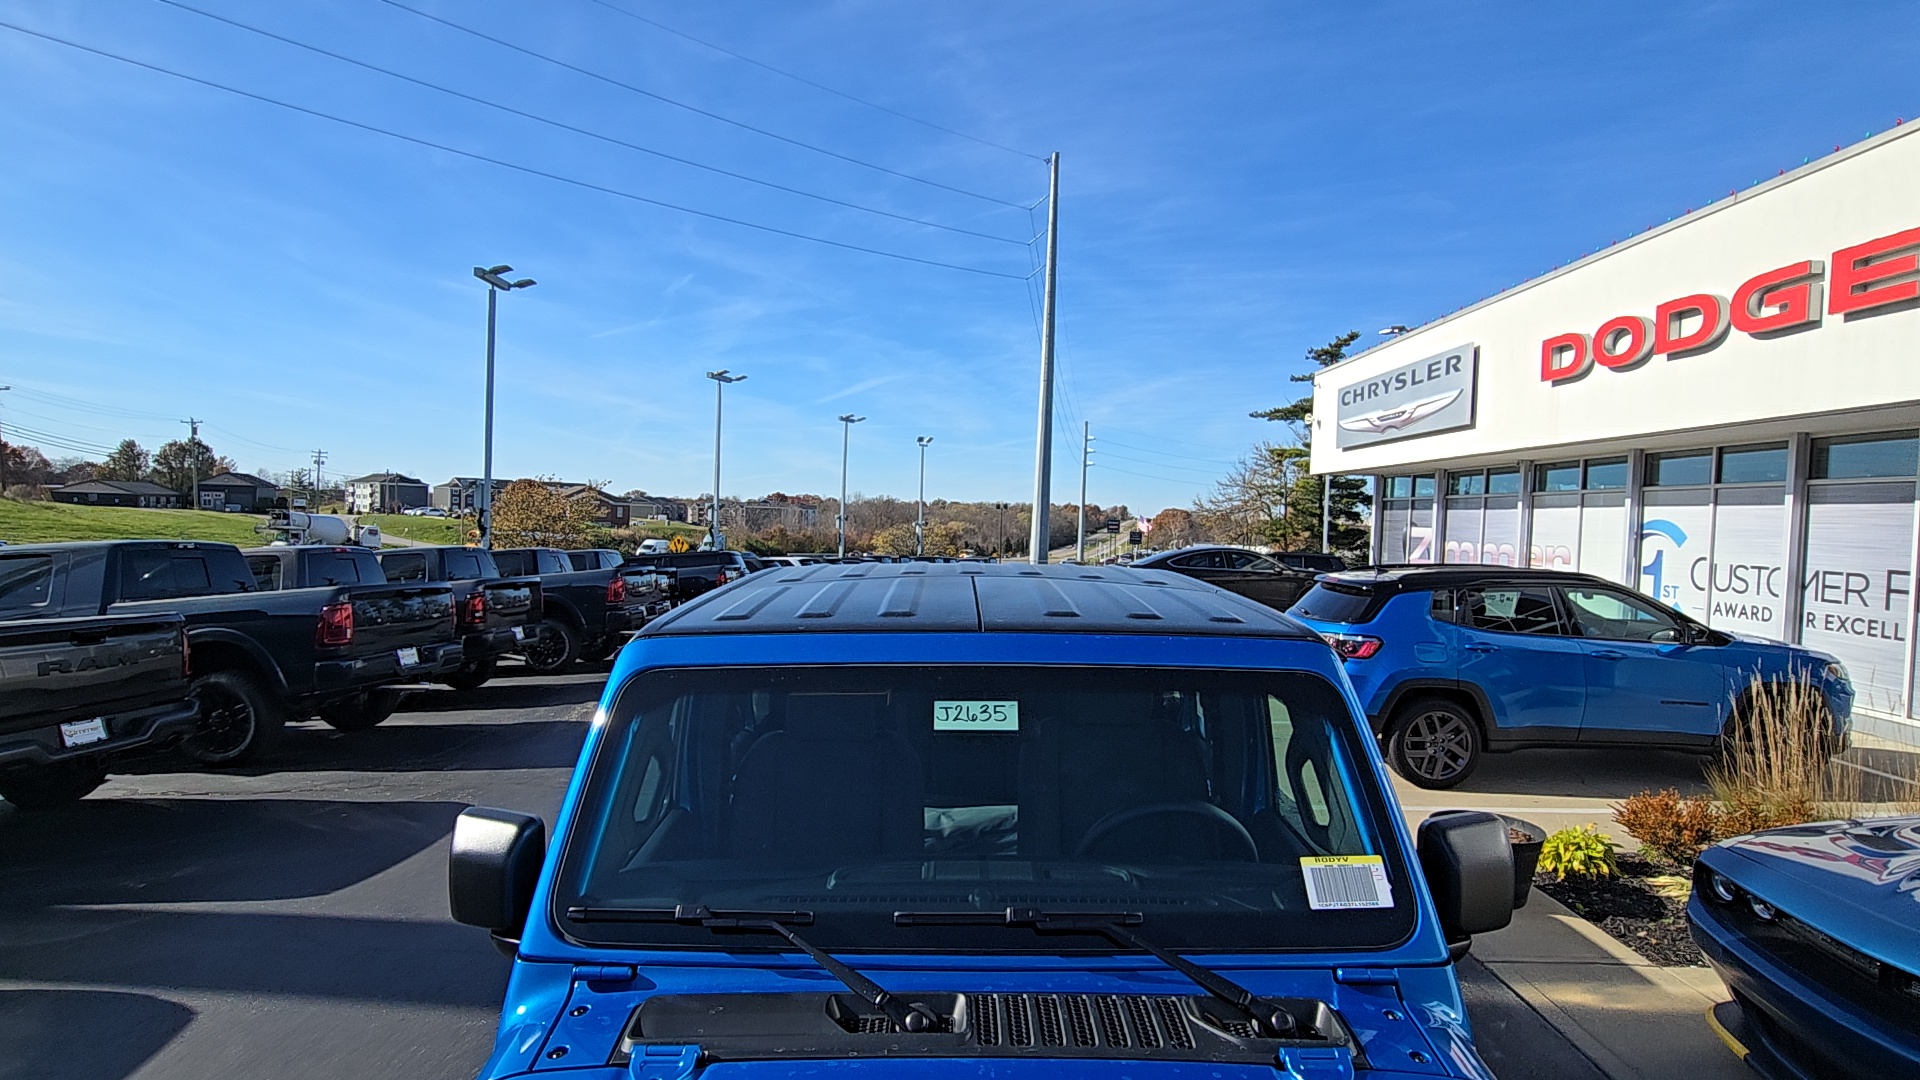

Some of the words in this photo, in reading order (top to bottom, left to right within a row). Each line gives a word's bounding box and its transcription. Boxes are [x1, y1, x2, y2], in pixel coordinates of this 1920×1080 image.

[1541, 227, 1920, 381] DODGE
[1341, 354, 1462, 406] CHRYSLER
[1409, 527, 1571, 568] Zmmer
[1713, 602, 1773, 622] AWARD
[37, 655, 139, 677] RAM
[936, 704, 1007, 722] J2635
